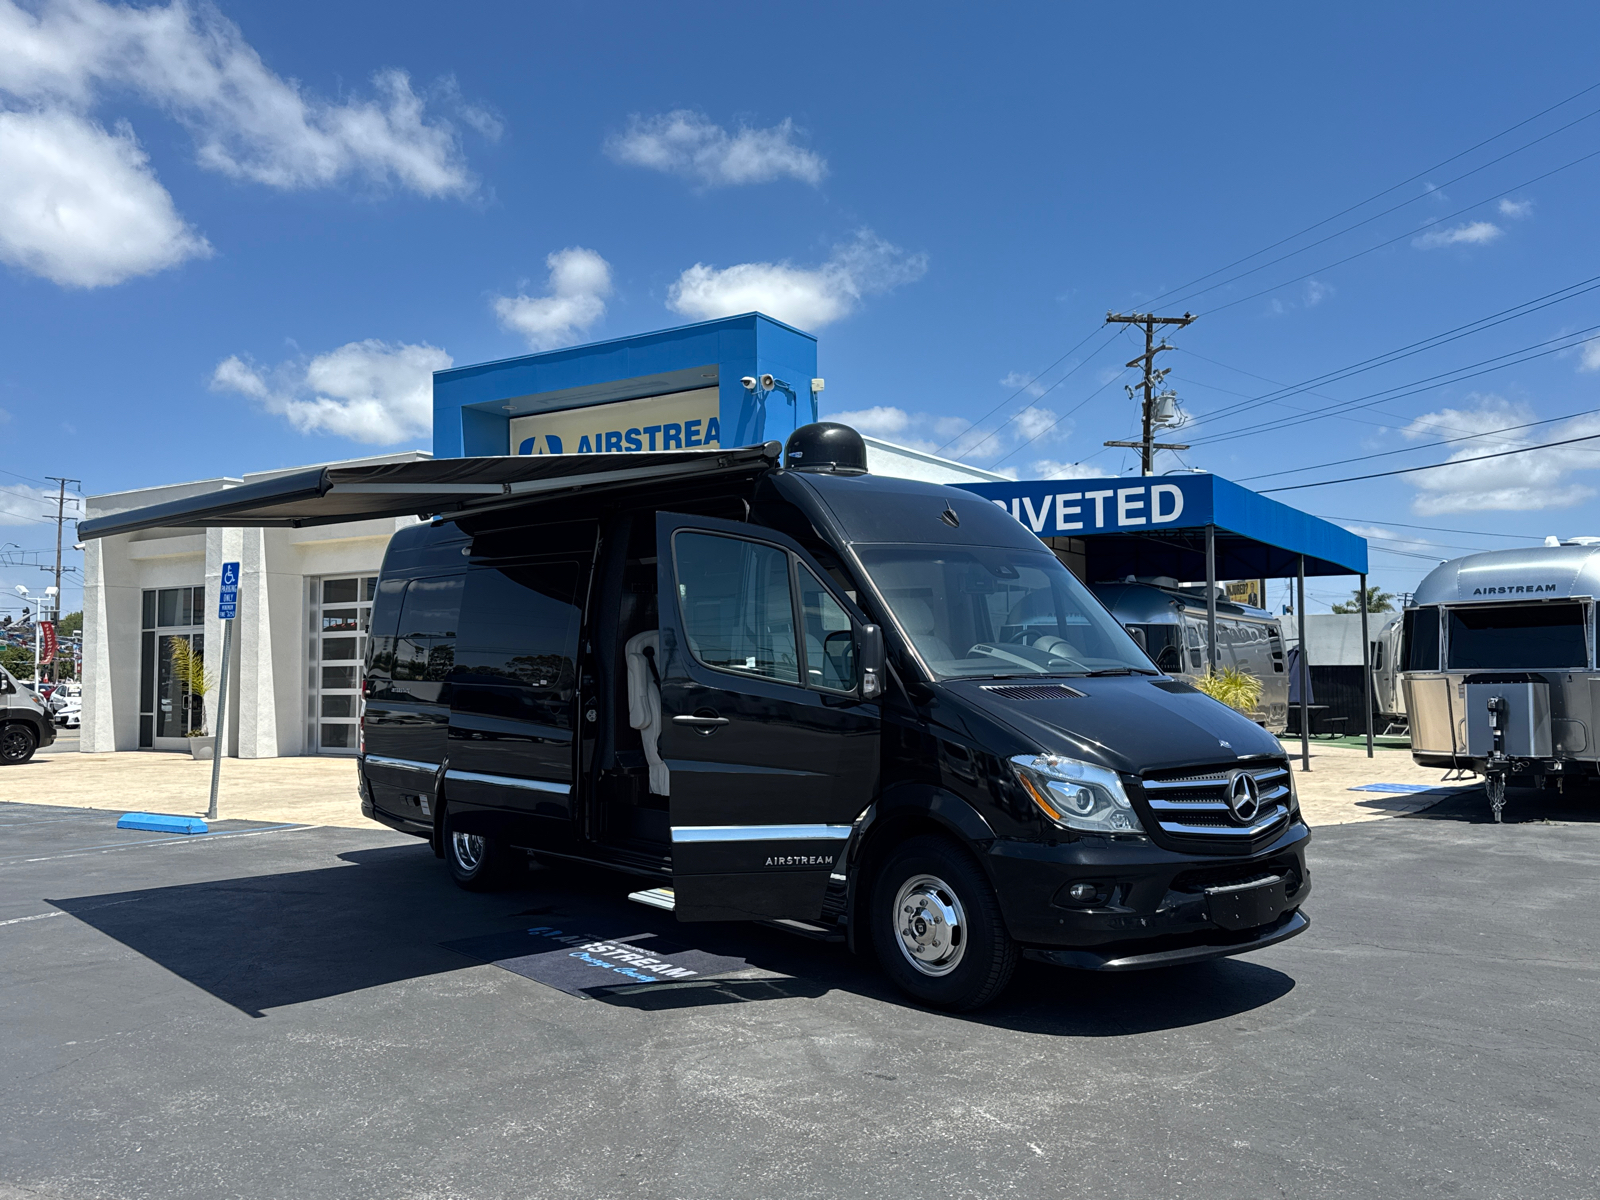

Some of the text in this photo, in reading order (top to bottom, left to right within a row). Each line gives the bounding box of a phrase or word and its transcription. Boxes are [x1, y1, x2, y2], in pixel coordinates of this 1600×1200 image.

[220, 584, 237, 593] PARKING
[1473, 584, 1556, 595] AIRSTREAM
[765, 855, 833, 866] AIRSTREAM
